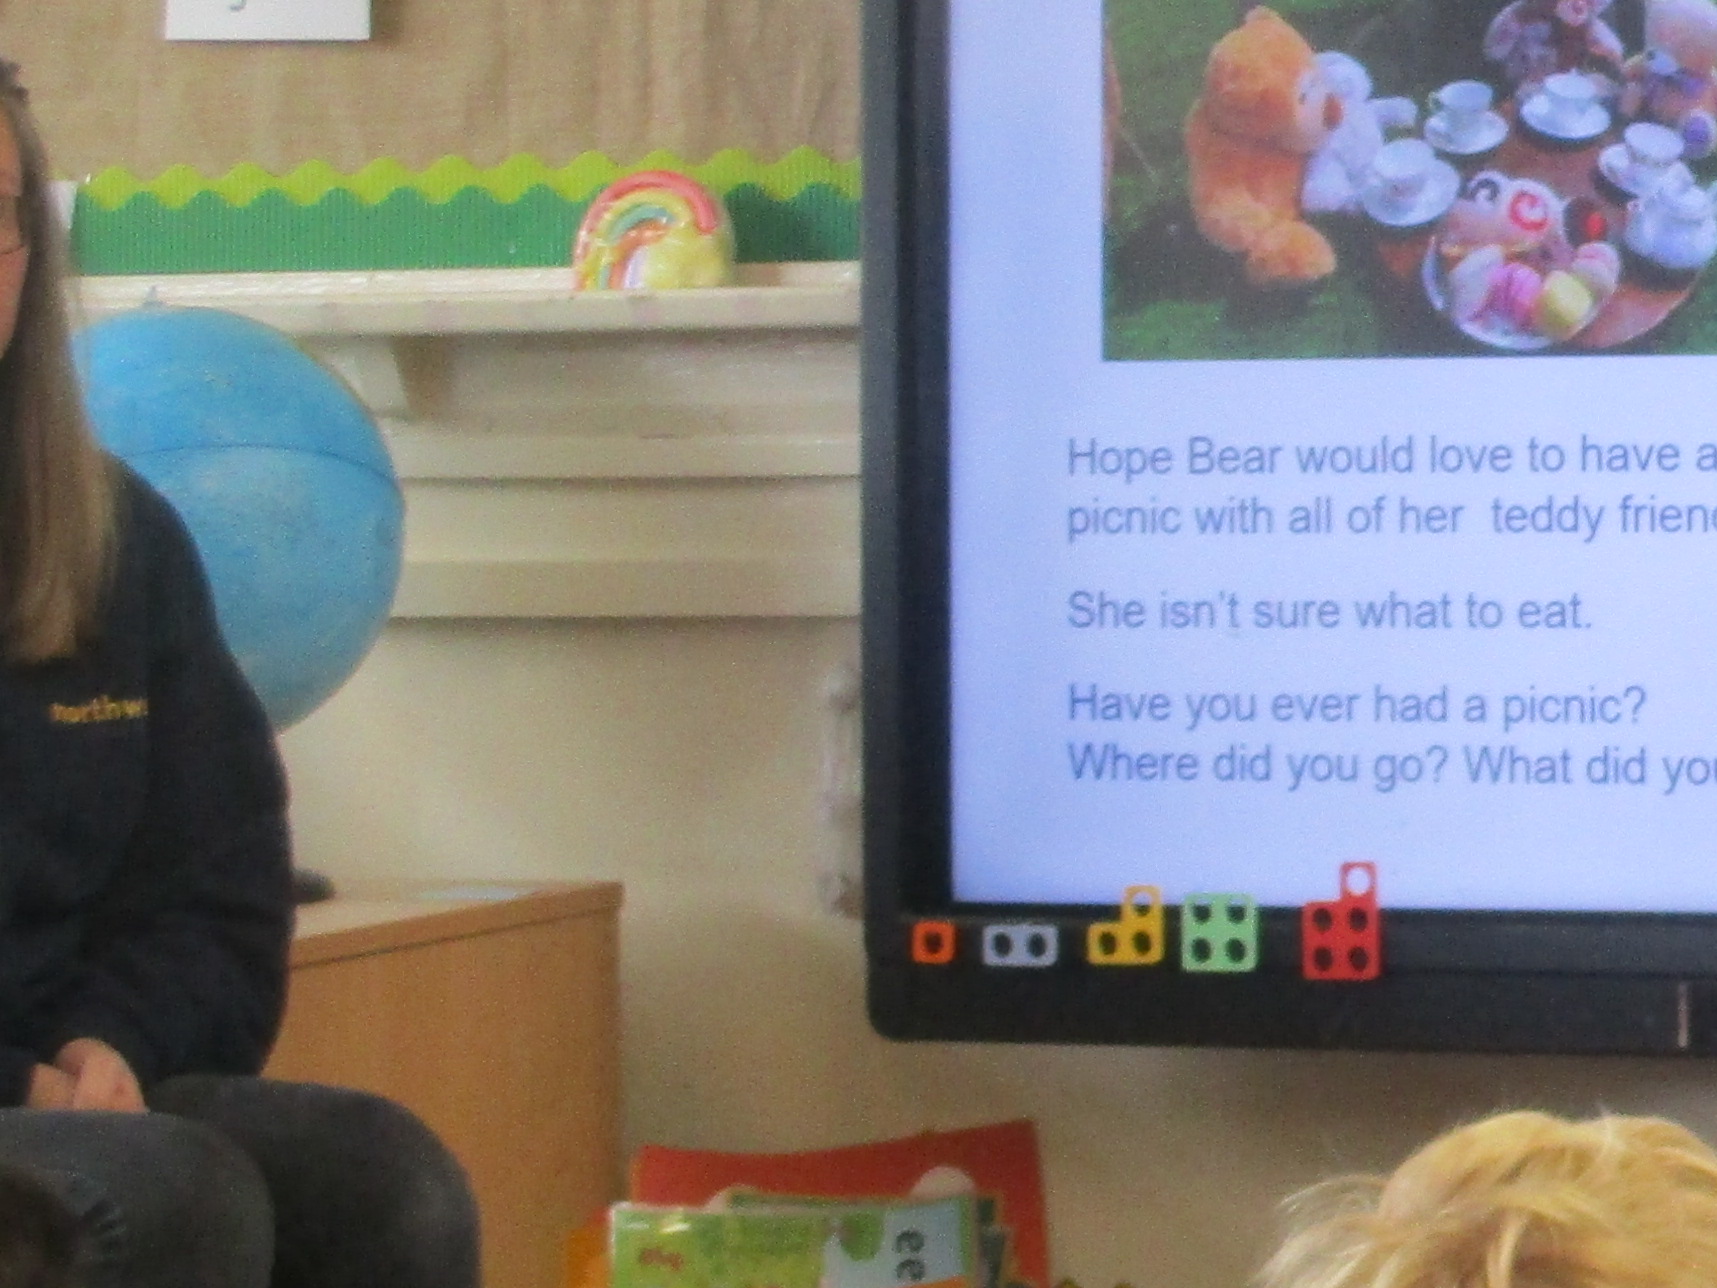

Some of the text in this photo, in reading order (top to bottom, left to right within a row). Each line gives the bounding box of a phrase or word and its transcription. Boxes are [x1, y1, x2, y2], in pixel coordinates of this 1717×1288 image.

[1068, 437, 1173, 486] Hope
[1187, 435, 1282, 475] Bear
[1297, 434, 1414, 474] would
[1430, 434, 1513, 473] love
[1529, 436, 1564, 472] to
[1580, 433, 1681, 472] have
[1068, 496, 1182, 544] picnic
[1195, 496, 1274, 534] with
[1288, 496, 1333, 534] all
[1346, 495, 1387, 534] of
[1399, 496, 1464, 534] her
[1492, 495, 1605, 544] teddy
[1067, 590, 1147, 629] She
[1253, 598, 1341, 629] sure
[1355, 591, 1453, 629] what
[1467, 592, 1504, 629] to
[1518, 592, 1593, 630] eat.
[1069, 683, 1647, 733] Have you ever had a picnic?
[1067, 743, 1199, 782] Where
[1213, 743, 1272, 782] did
[1286, 751, 1358, 793] you
[1373, 744, 1449, 793] go?
[1464, 744, 1572, 785] What
[1586, 746, 1647, 785] did
